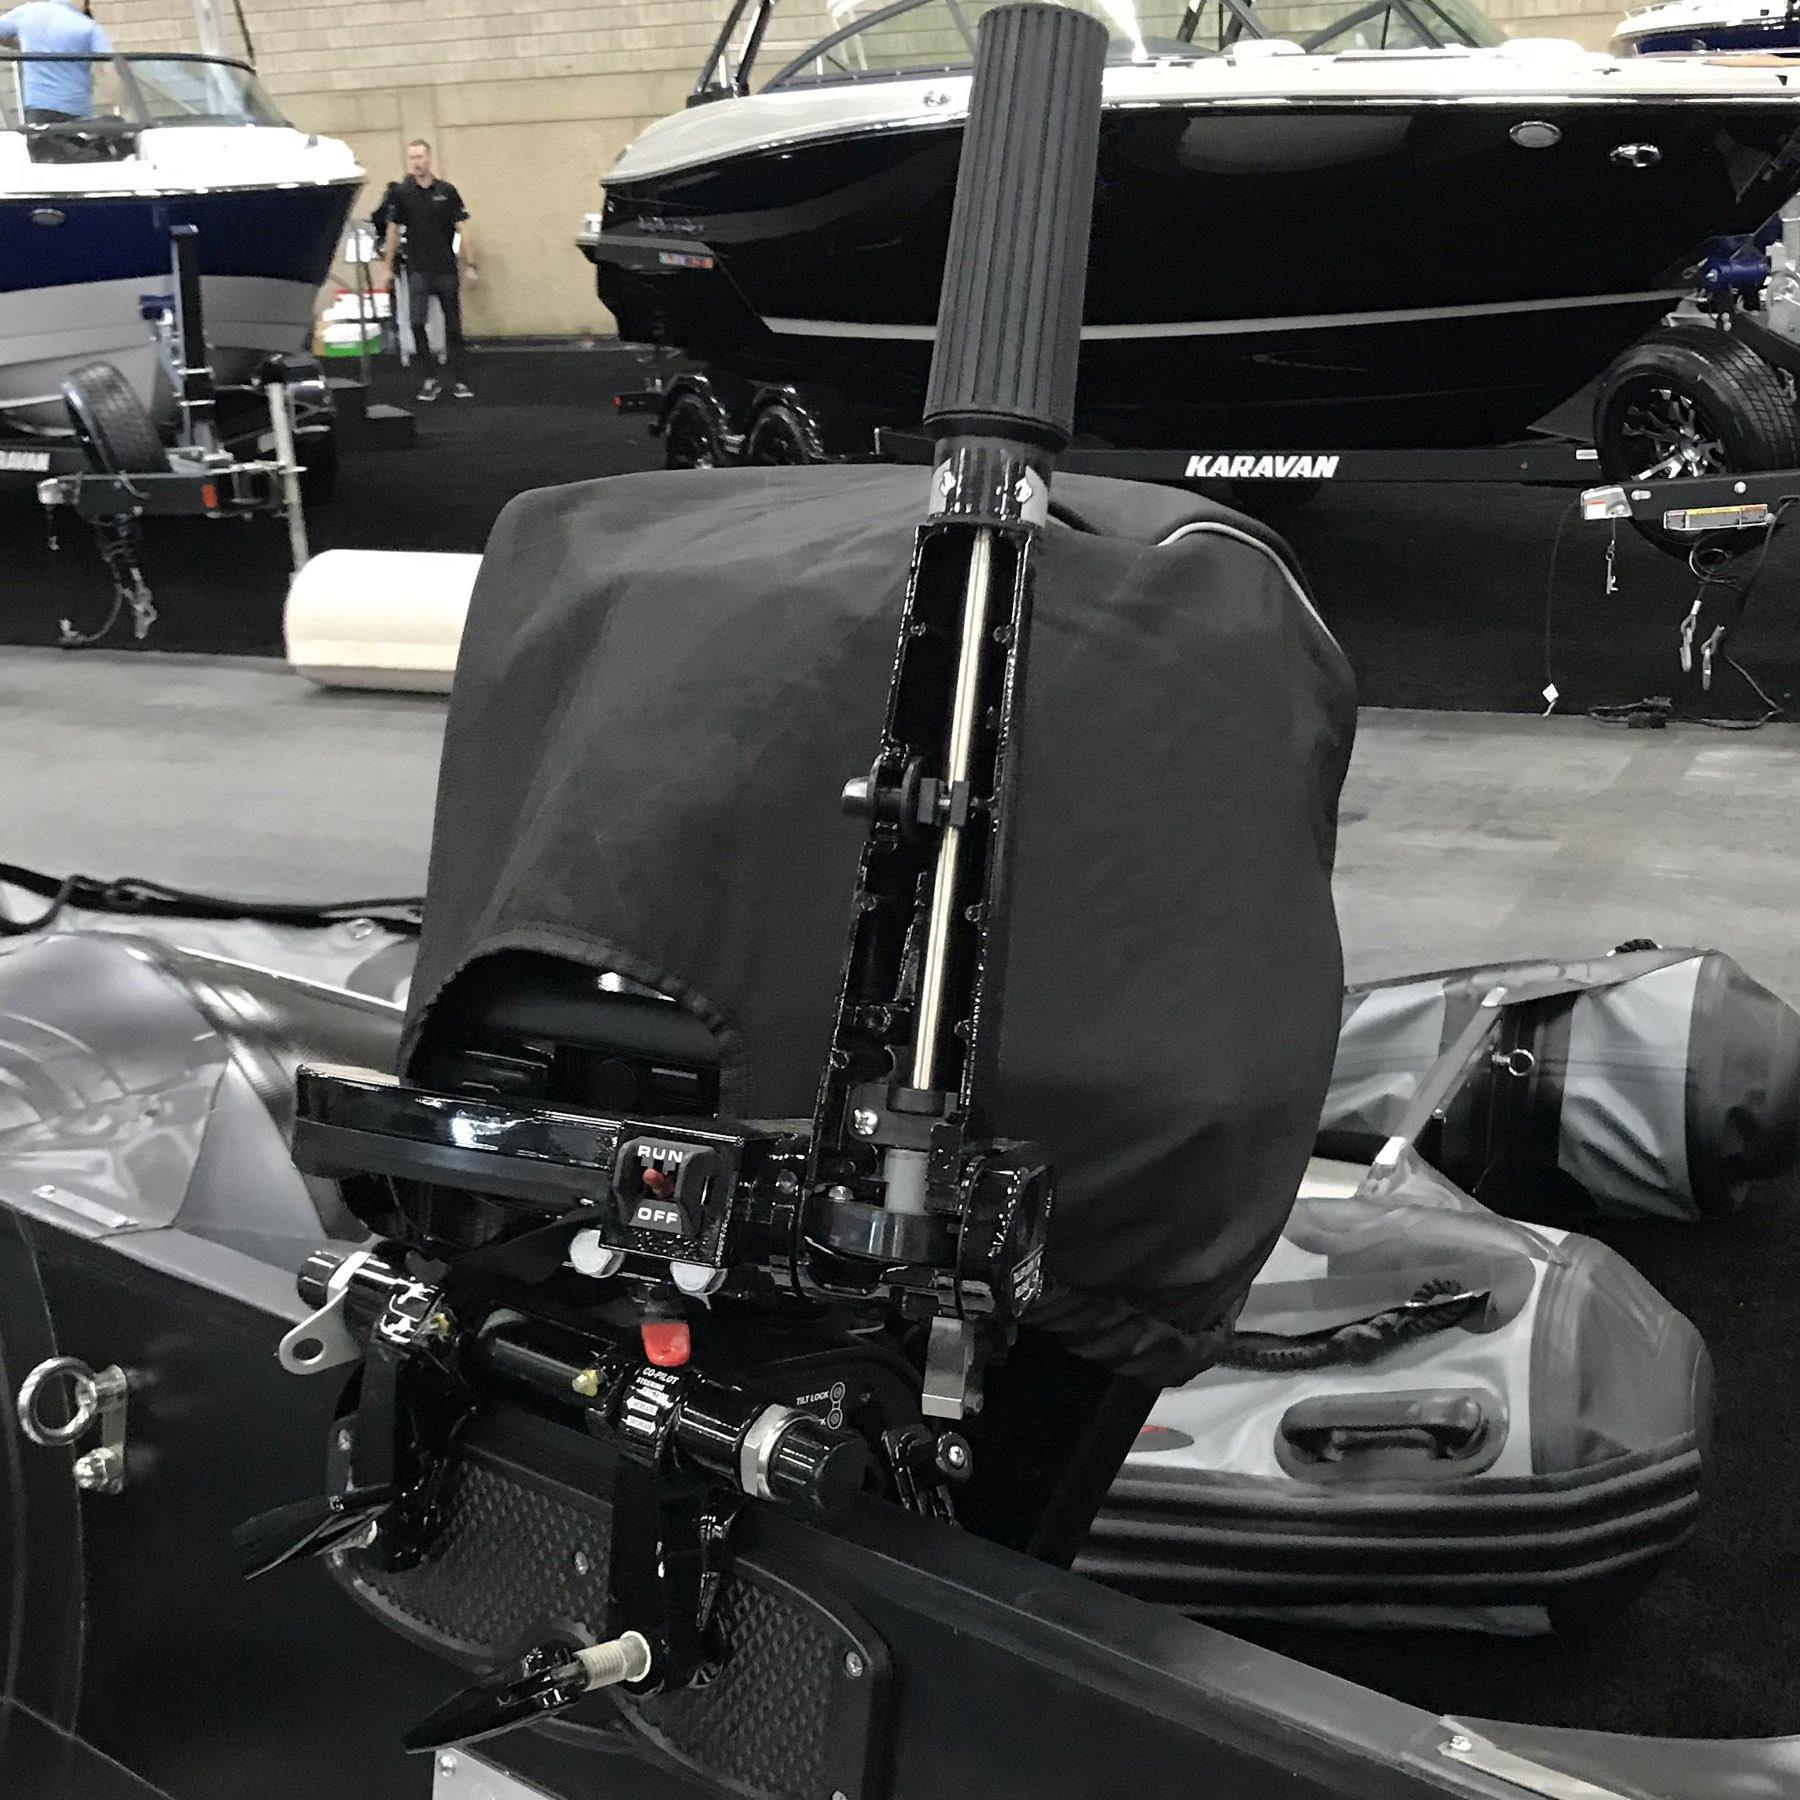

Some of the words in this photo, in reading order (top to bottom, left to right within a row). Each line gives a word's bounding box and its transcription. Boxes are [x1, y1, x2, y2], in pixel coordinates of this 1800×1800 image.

[1184, 455, 1340, 478] KARAVAN
[637, 1144, 683, 1163] RUN
[637, 1206, 679, 1224] OFF
[642, 1367, 680, 1385] CO-PILOT
[796, 1395, 811, 1406] TILT
[810, 1391, 830, 1403] LOCK
